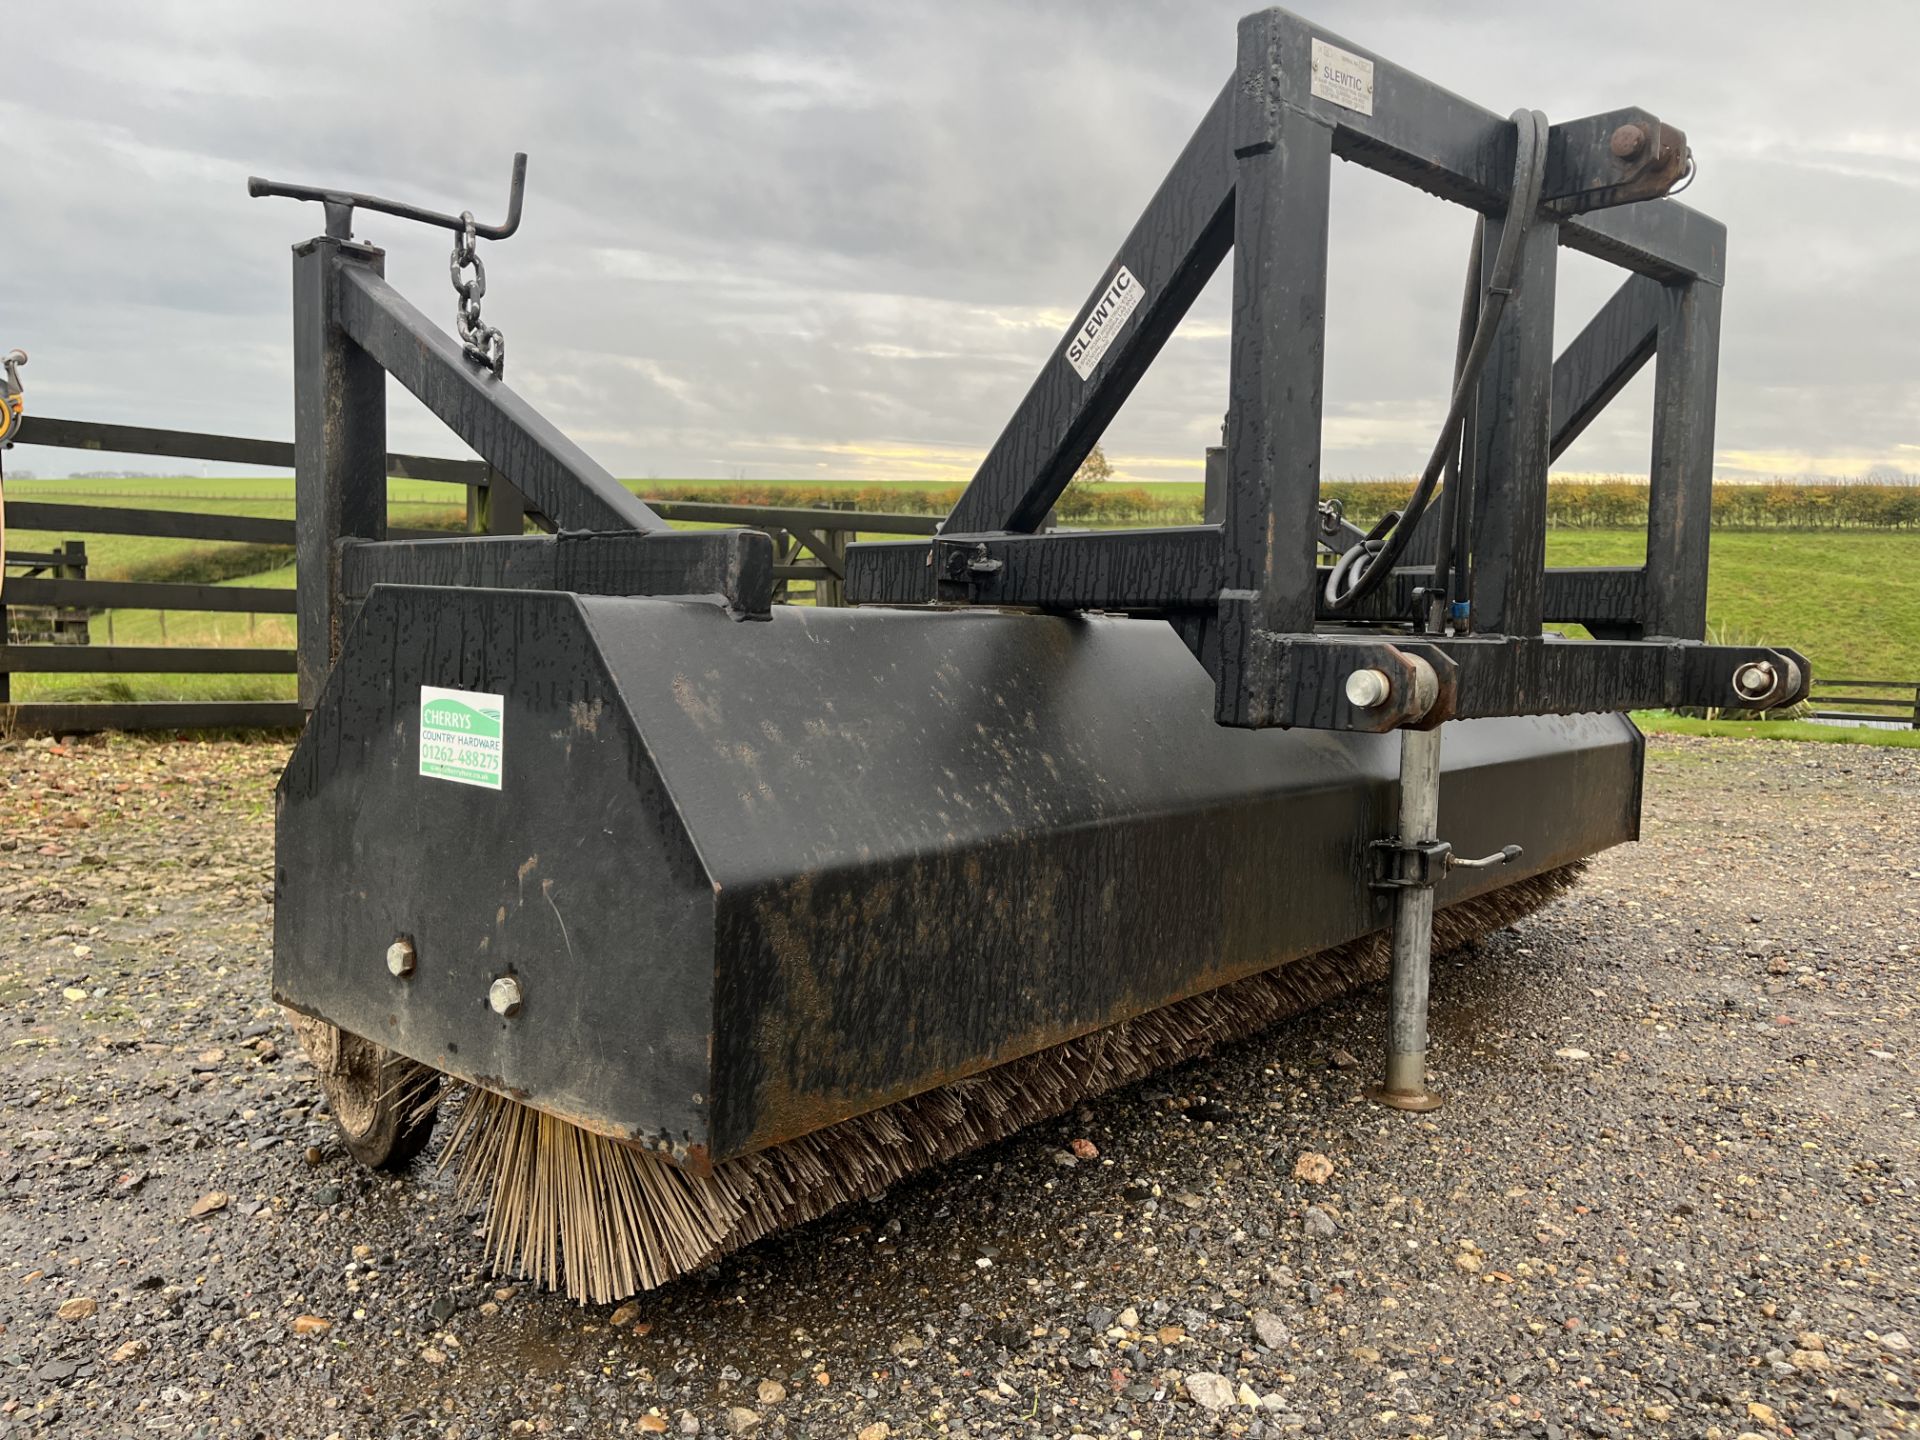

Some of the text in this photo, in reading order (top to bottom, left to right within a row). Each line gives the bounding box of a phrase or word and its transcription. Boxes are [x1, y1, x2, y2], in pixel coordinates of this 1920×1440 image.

[1324, 65, 1362, 91] SLEWTIC
[1069, 271, 1130, 362] SLEWTIC
[424, 708, 472, 729] CHERRYS
[422, 730, 500, 751] COUNTRY HARDWARE
[422, 743, 499, 770] 01262 488275
